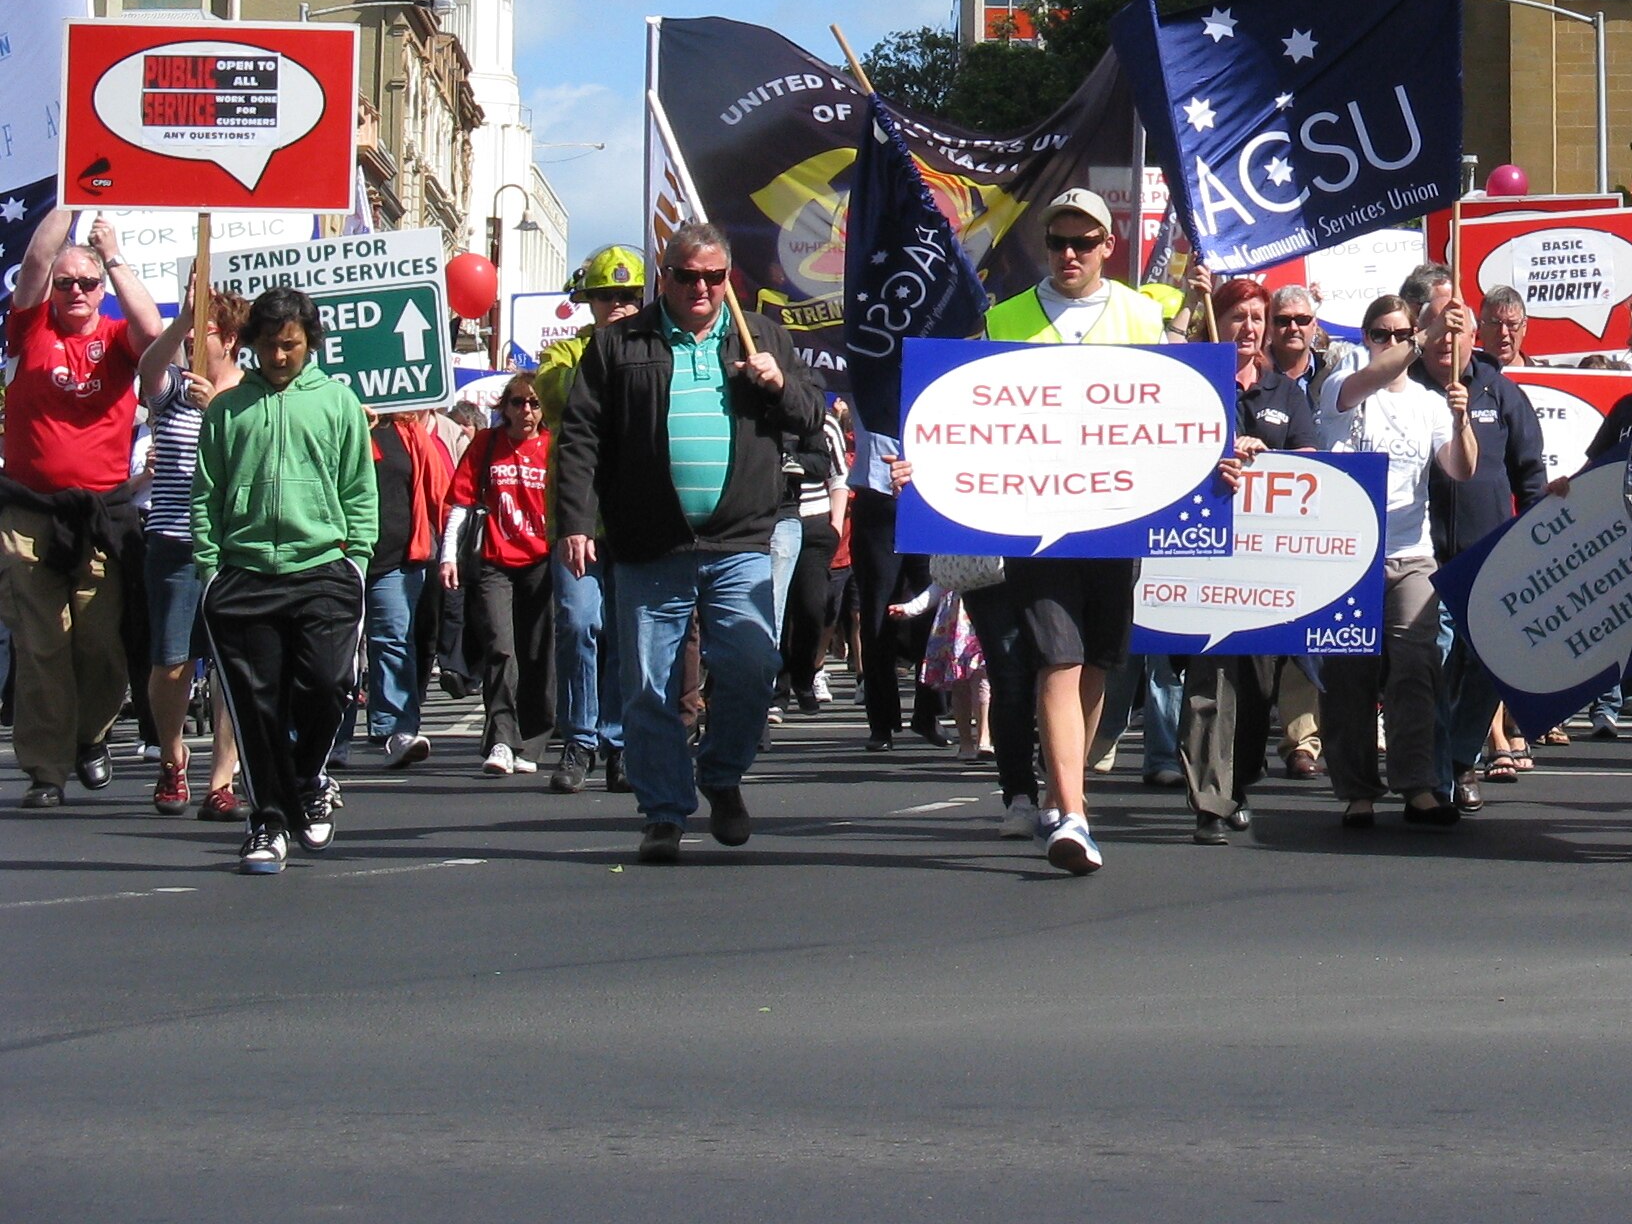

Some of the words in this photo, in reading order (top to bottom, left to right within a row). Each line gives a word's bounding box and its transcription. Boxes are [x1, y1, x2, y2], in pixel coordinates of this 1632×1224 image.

[144, 57, 217, 89] PUBLIC
[216, 60, 254, 72] OPEN
[257, 61, 276, 72] TO
[232, 76, 258, 87] ALL
[143, 94, 216, 125] SERVICE
[216, 95, 246, 104] WORK
[250, 95, 278, 104] DONE
[235, 107, 257, 115] FOR
[719, 73, 824, 126] UNITED
[216, 117, 276, 126] CUSTOMERS
[812, 103, 852, 123] OF
[163, 131, 185, 140] ANY
[189, 131, 256, 140] QUESTIONS?
[1243, 226, 1320, 266] Community
[1317, 200, 1386, 238] Services
[1387, 180, 1439, 211] Union
[121, 226, 177, 246] FOR
[1372, 239, 1424, 254] CUTS
[1542, 240, 1583, 252] BASIC
[228, 248, 301, 273] STAND
[307, 244, 337, 262] UP
[343, 239, 388, 259] FOR
[1531, 253, 1596, 267] SERVICES
[250, 266, 328, 294] PUBLIC
[332, 257, 439, 285] SERVICES
[1528, 269, 1568, 281] MUST
[1570, 268, 1587, 279] BE
[1592, 267, 1602, 277] A
[1322, 286, 1388, 302] ERVICE
[1527, 281, 1602, 303] PRIORITY
[781, 301, 844, 325] STREN
[541, 326, 579, 338] HAND
[357, 364, 433, 397] WAY
[972, 384, 1063, 408] SAVE
[1086, 382, 1162, 405] OUR
[1535, 406, 1567, 420] STE
[915, 423, 1062, 446] MENTAL
[1080, 421, 1222, 446] HEALTH
[1360, 437, 1432, 461] HACSU
[490, 464, 547, 482] PROTECT
[954, 469, 1135, 497] SERVICES
[1239, 471, 1319, 516] TF?
[1530, 506, 1577, 546] Cut
[1148, 527, 1228, 550] HACSU
[1234, 533, 1263, 552] HE
[1275, 534, 1357, 556] FUTURE
[1499, 519, 1628, 618] Politicians
[1142, 583, 1188, 603] FOR
[1200, 584, 1296, 608] SERVICES
[1305, 627, 1377, 648] HACSU
[1521, 604, 1572, 648] Not
